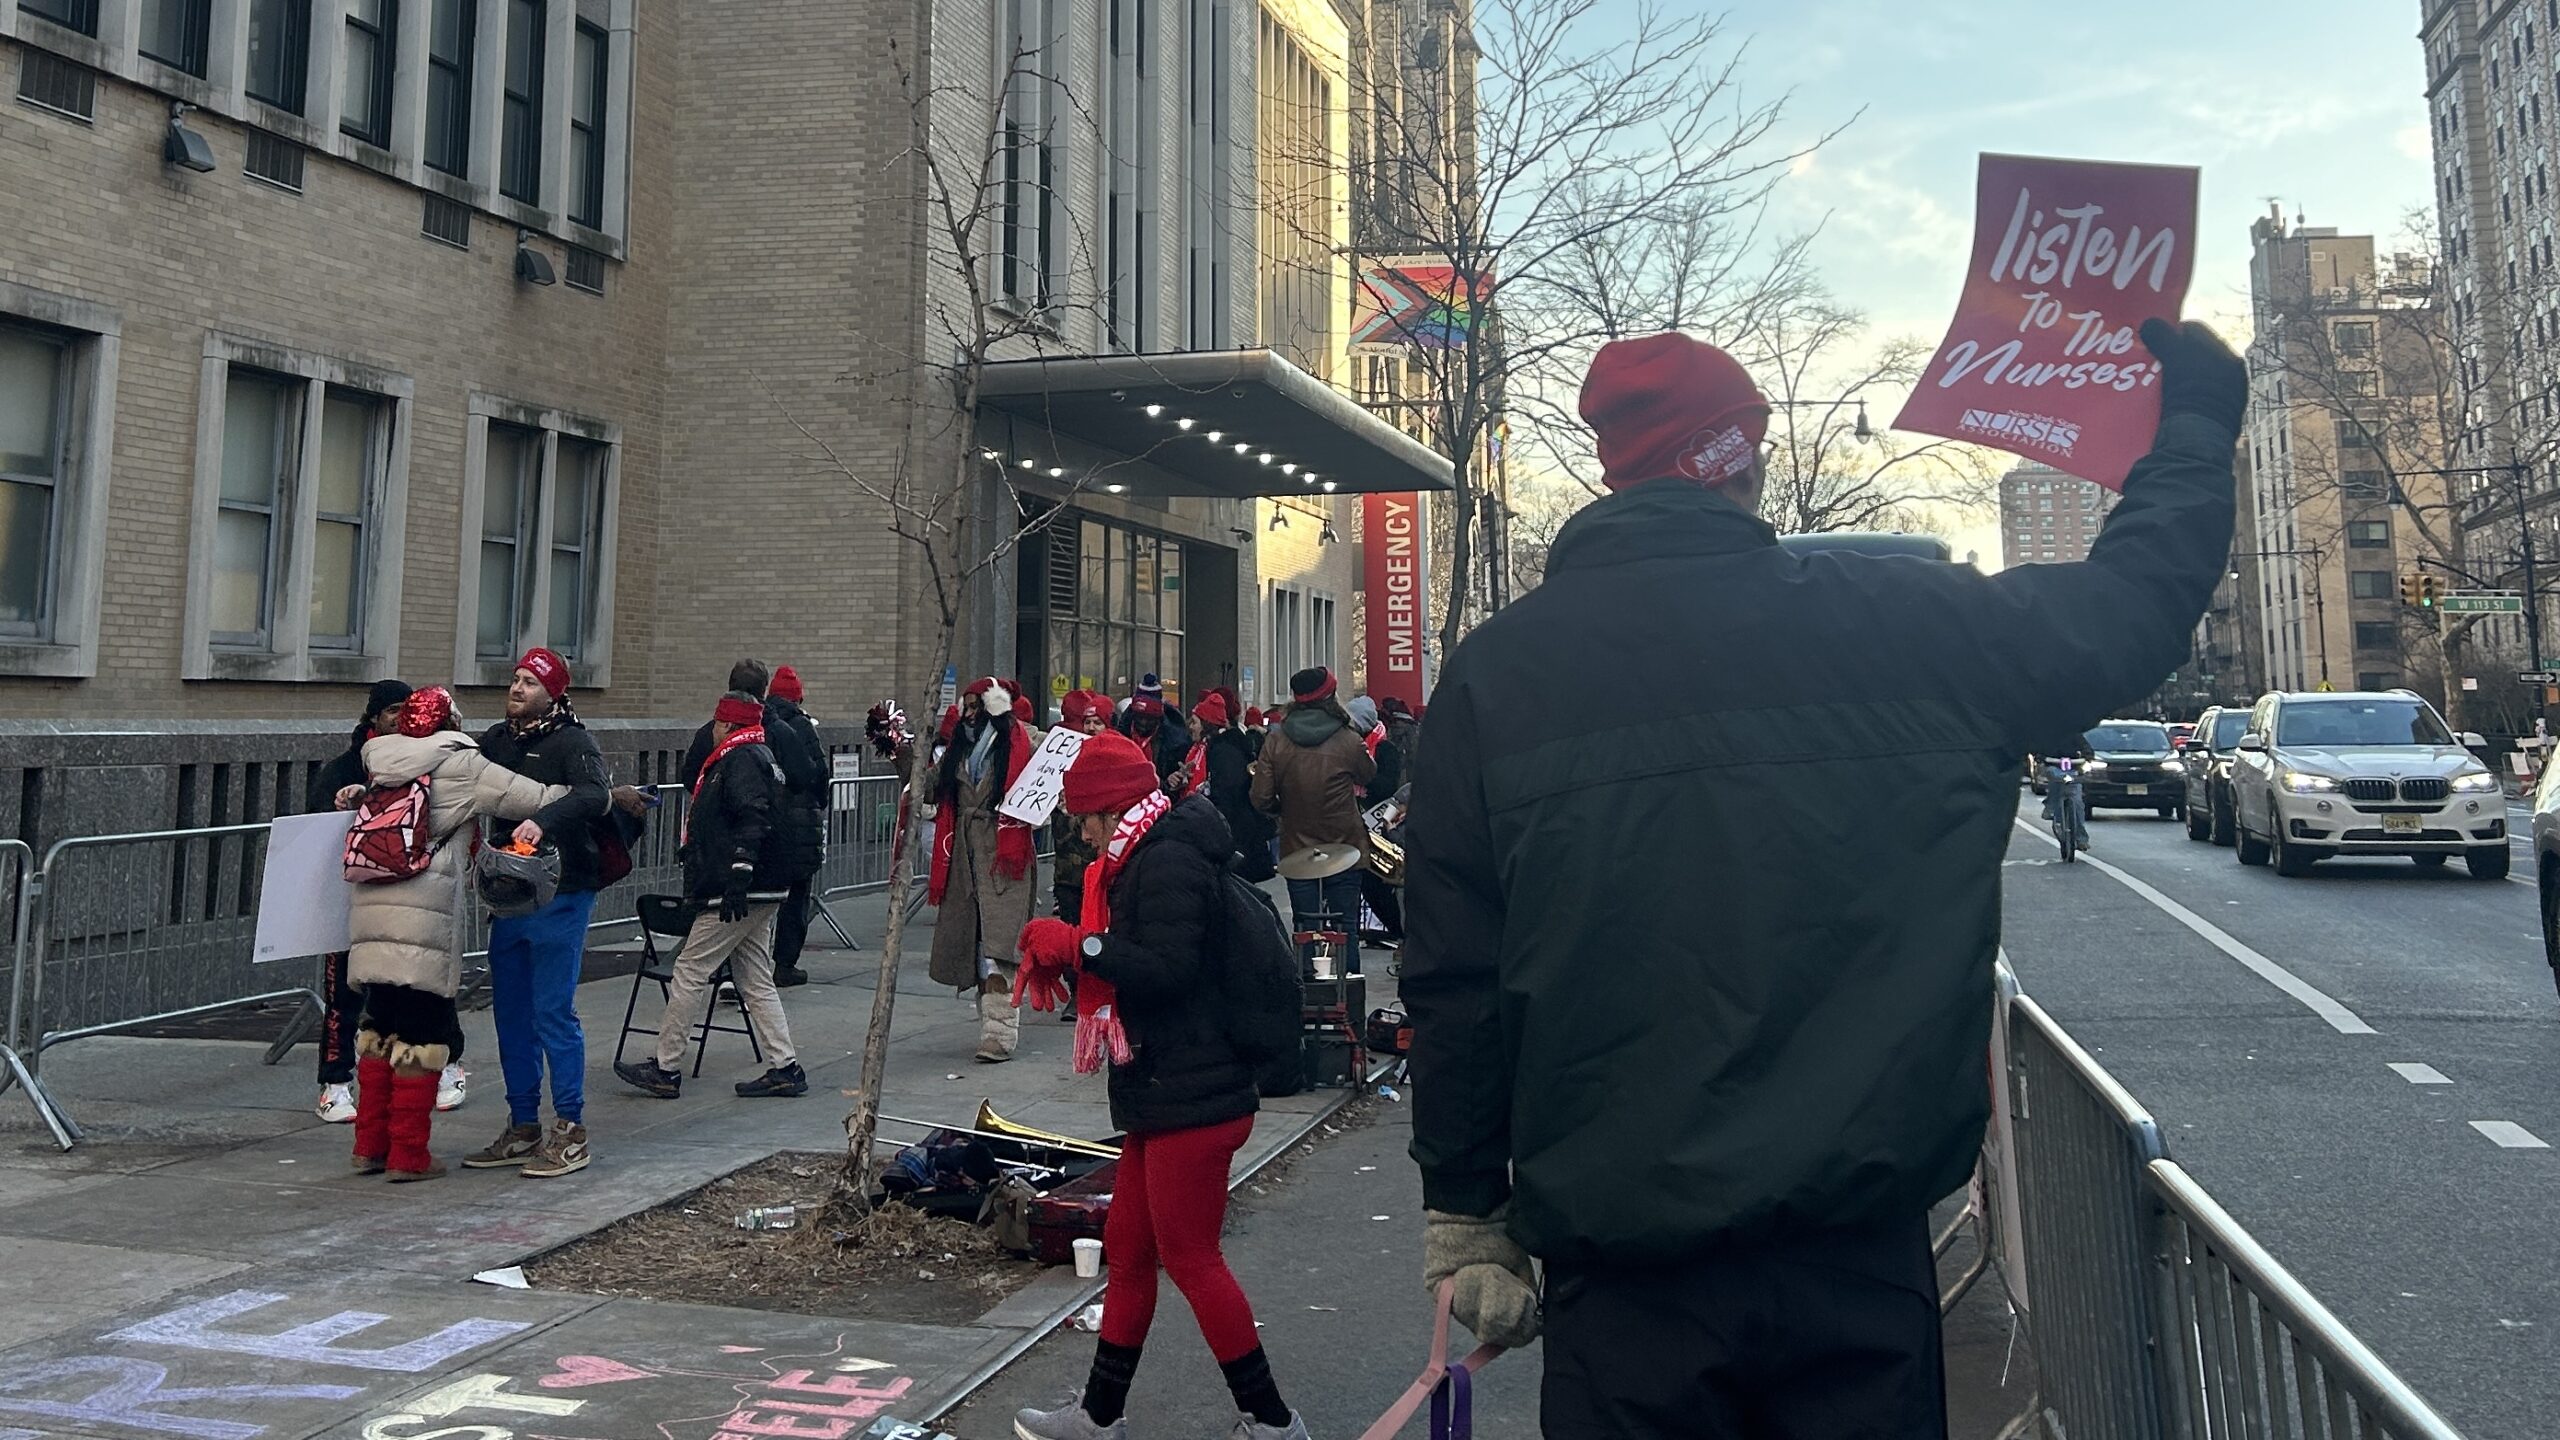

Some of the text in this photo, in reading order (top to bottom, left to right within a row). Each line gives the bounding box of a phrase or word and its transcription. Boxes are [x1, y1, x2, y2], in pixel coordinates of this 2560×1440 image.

[1956, 423, 2074, 458] ASSOCIATION
[1960, 408, 2080, 448] NURSES
[1385, 499, 1414, 672] EMERGENCY
[2458, 599, 2469, 610] W
[2473, 599, 2490, 610] 113
[1046, 732, 1084, 758] CEO
